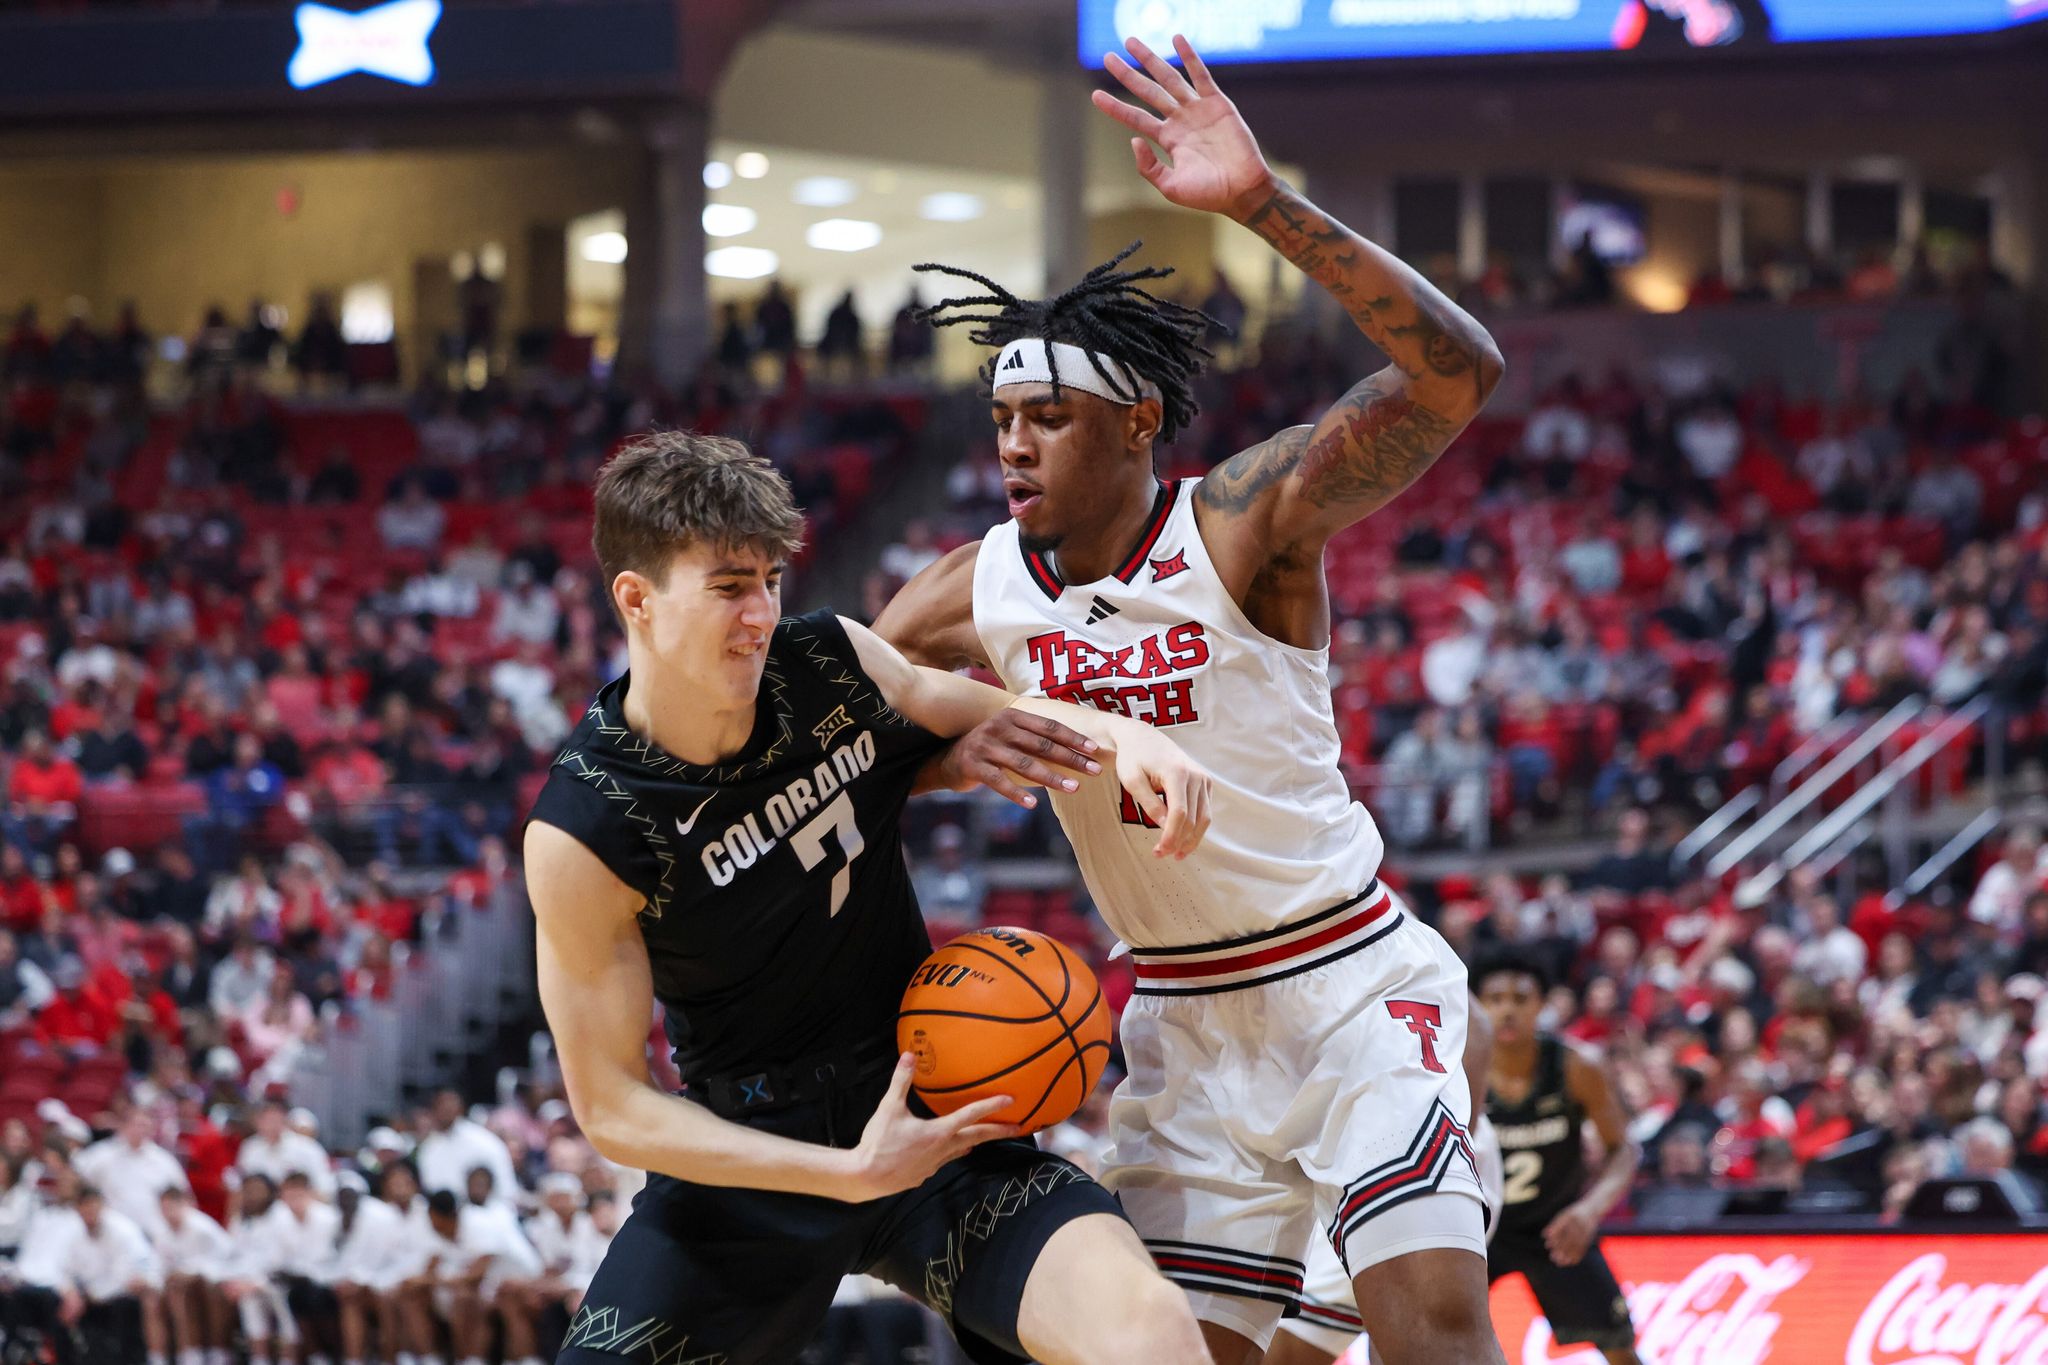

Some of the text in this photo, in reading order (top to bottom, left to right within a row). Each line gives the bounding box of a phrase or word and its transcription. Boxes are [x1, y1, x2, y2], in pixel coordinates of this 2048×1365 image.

[1026, 620, 1210, 691] TEXAS
[701, 730, 876, 887] COLORADO
[788, 789, 865, 919] 7
